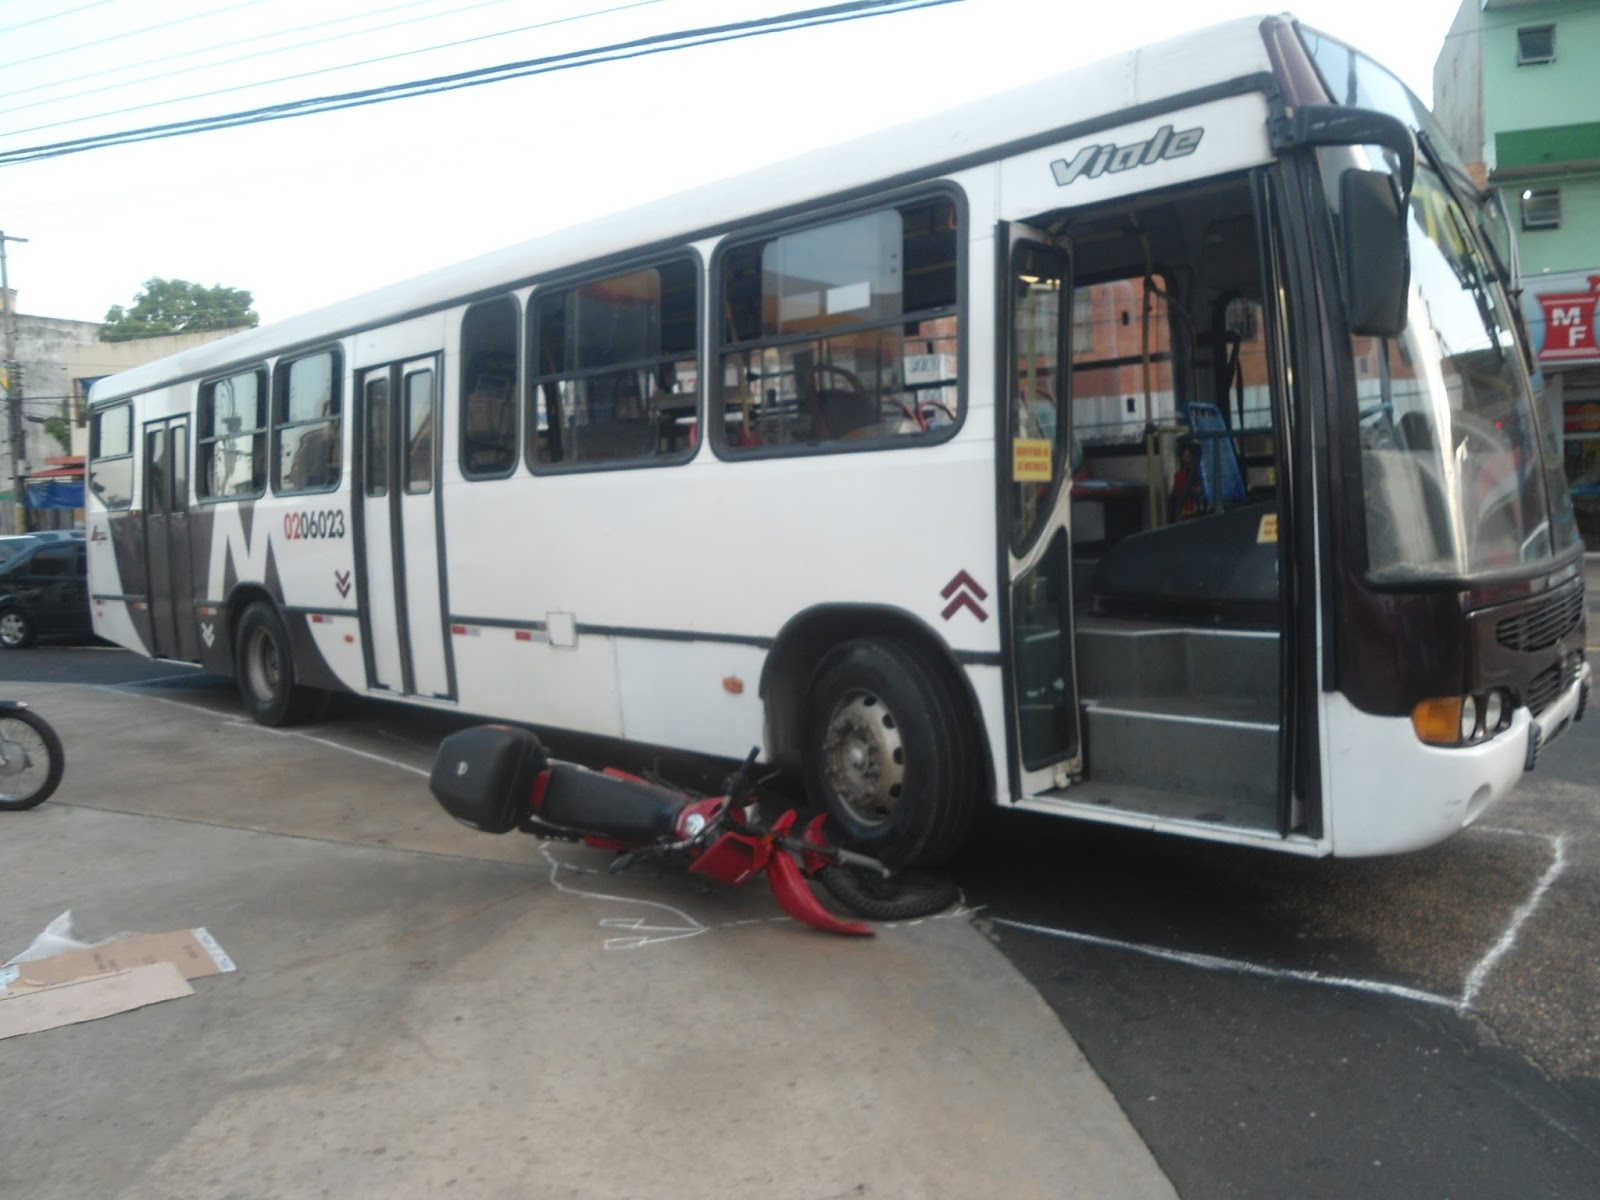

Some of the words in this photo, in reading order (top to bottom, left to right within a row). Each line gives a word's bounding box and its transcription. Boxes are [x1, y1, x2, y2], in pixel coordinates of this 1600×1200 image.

[1049, 124, 1204, 187] Viale
[1552, 306, 1581, 327] M
[1568, 325, 1587, 348] F
[283, 508, 345, 541] 0206023
